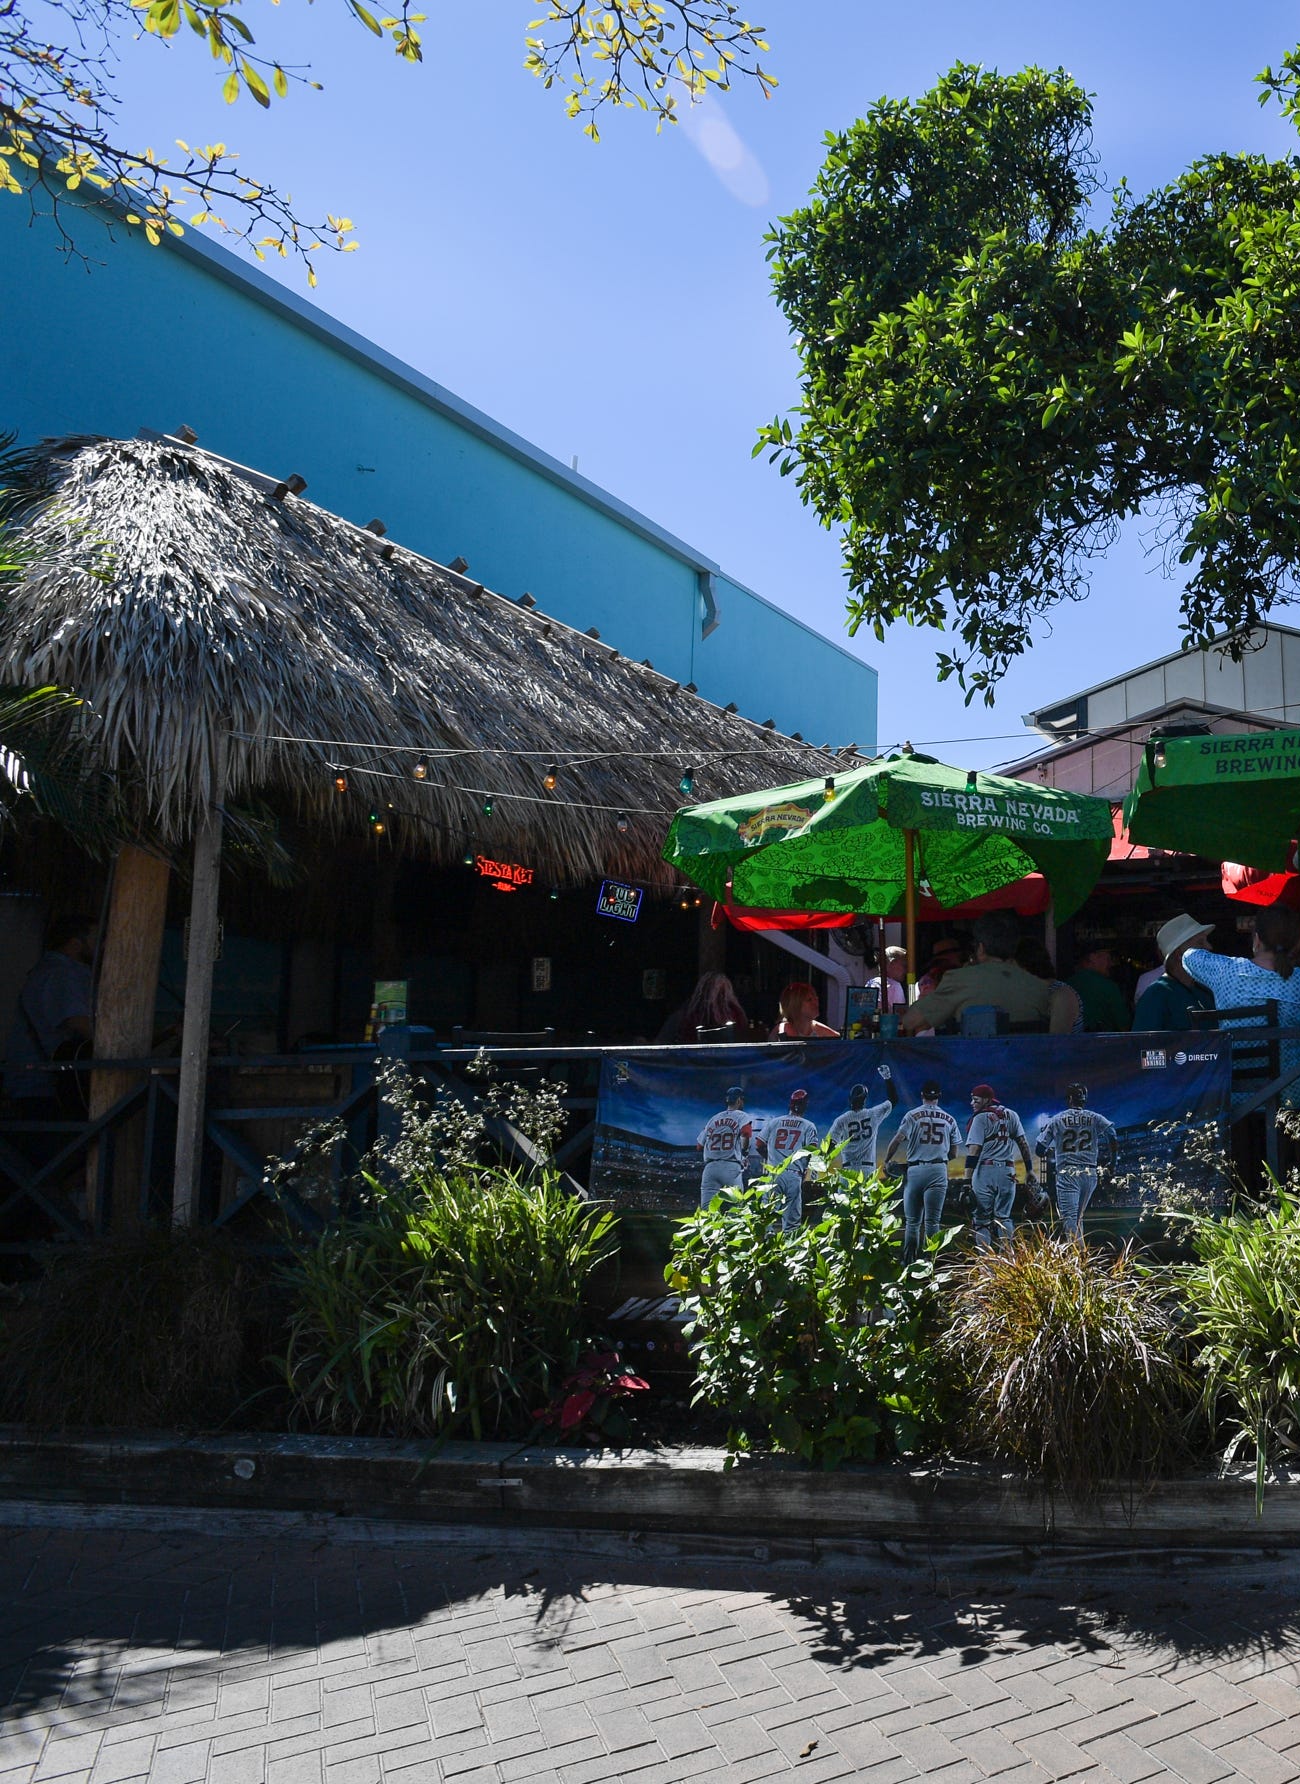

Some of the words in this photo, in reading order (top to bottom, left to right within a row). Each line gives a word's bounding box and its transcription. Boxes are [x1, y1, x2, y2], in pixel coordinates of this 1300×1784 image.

[1200, 737, 1275, 755] SIERRA
[777, 814, 805, 822] NEVADA
[921, 791, 997, 815] SIERRA
[1006, 799, 1080, 824] NEVADA
[956, 812, 1026, 832] BREWING
[1033, 821, 1054, 835] CO.
[600, 896, 638, 918] LIGHT
[1188, 1054, 1218, 1062] DIRECTV
[782, 1119, 802, 1128] TROUT
[913, 1109, 954, 1125] VERLANDER
[775, 1129, 801, 1150] 27
[848, 1118, 873, 1141] 25
[919, 1122, 945, 1145] 35
[711, 1133, 734, 1151] 28
[1063, 1129, 1092, 1152] 22
